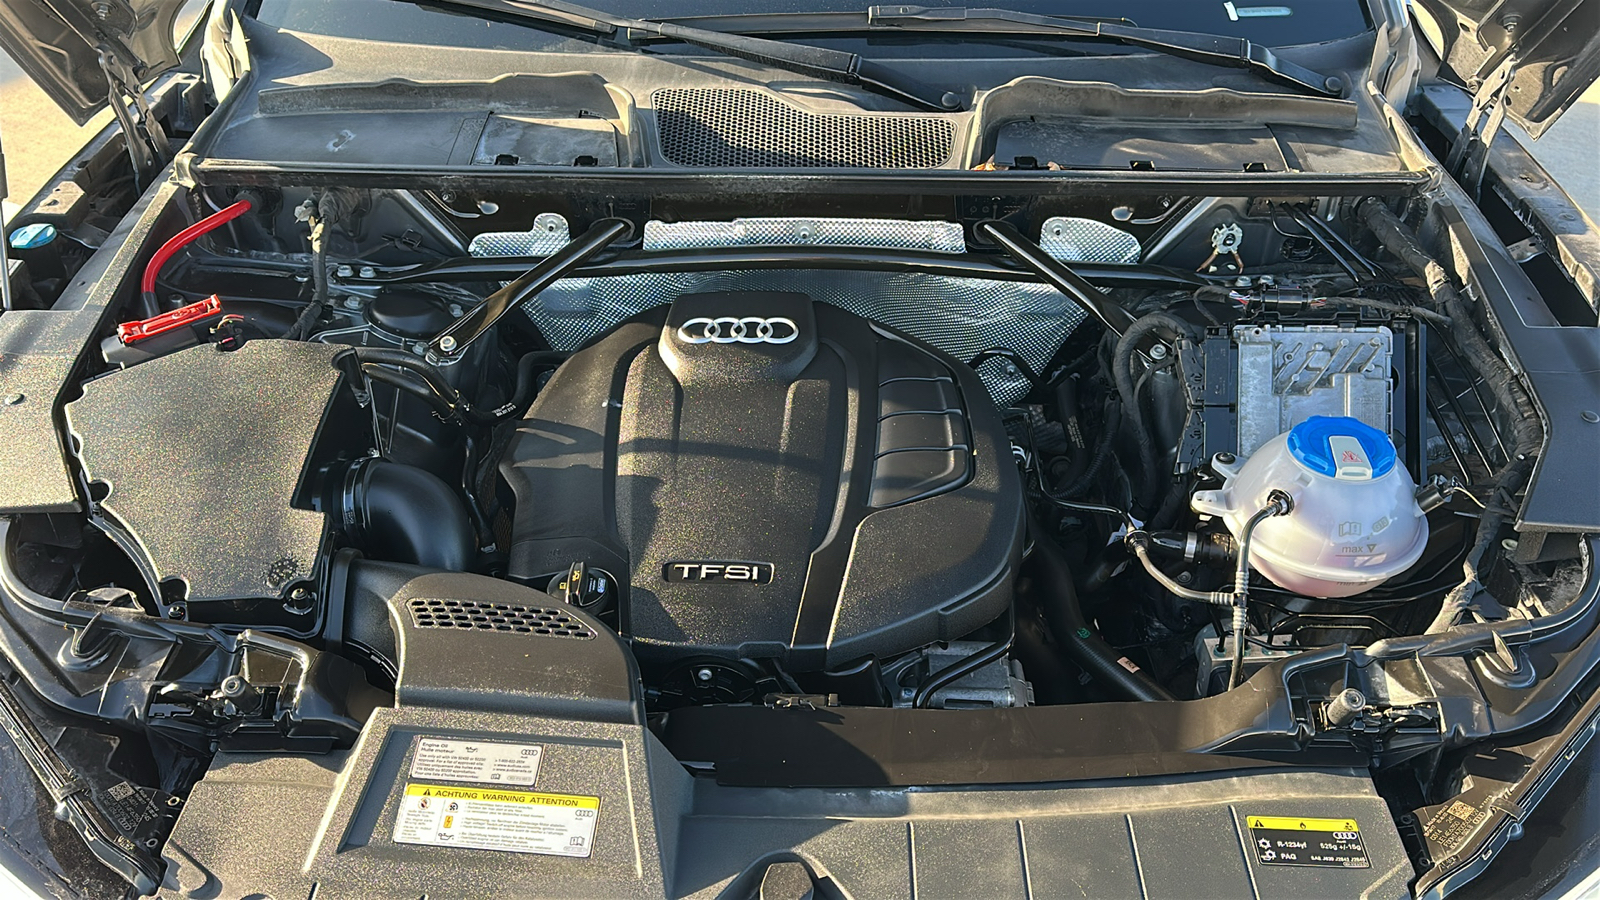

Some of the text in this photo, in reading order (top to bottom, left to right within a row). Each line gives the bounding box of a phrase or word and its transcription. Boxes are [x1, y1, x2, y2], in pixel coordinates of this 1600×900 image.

[674, 564, 759, 580] TFSI
[435, 790, 478, 799] ACHTUNG
[482, 794, 526, 802] WARNING
[529, 797, 578, 806] ATTENTION
[1276, 841, 1307, 850] R-1234yf
